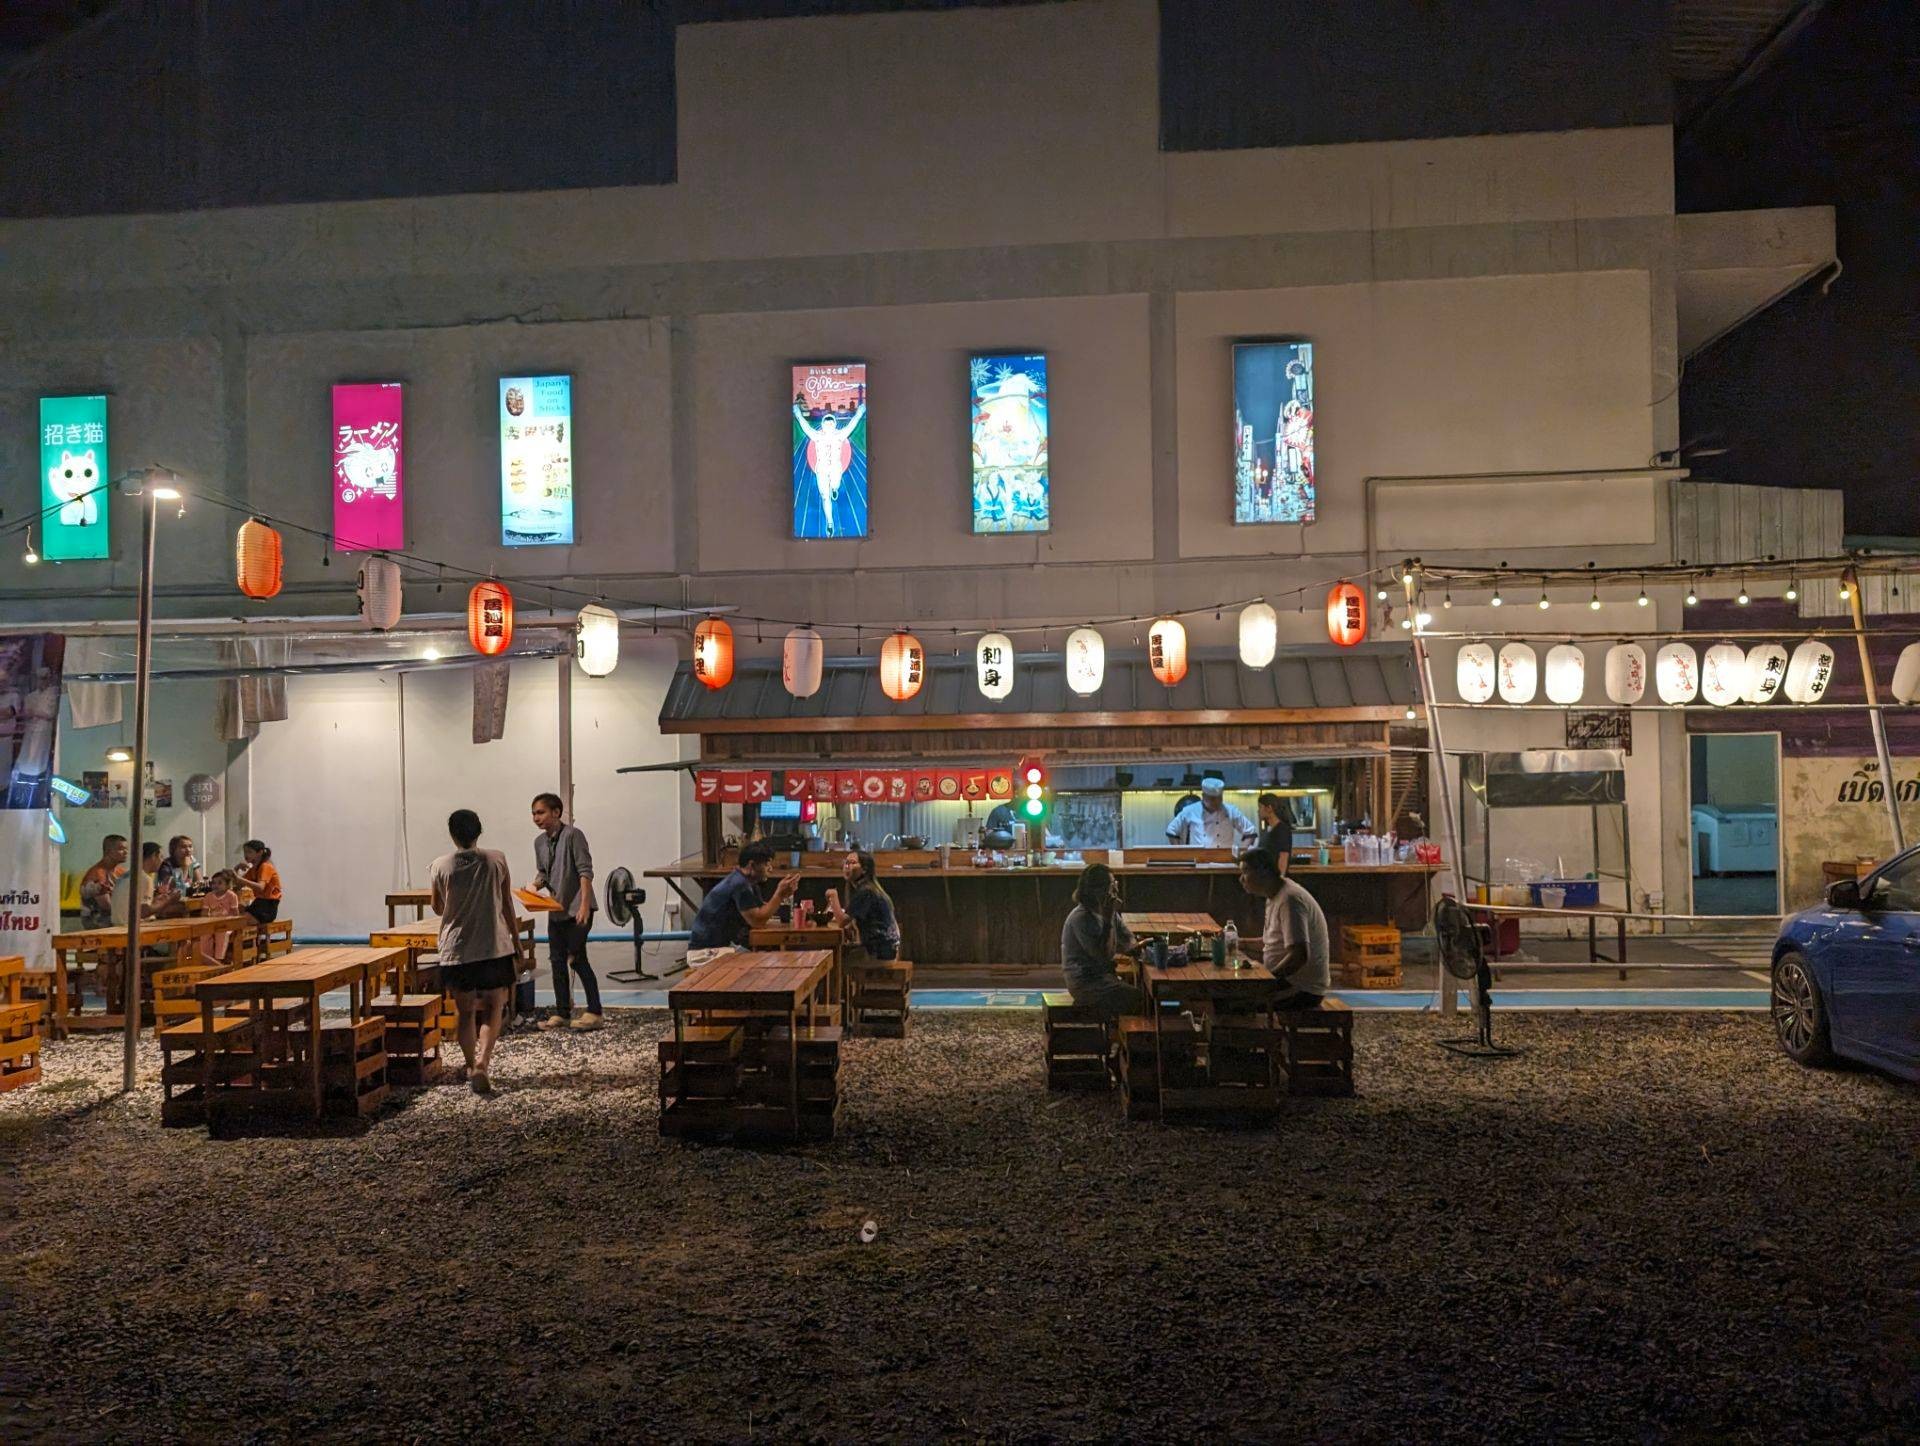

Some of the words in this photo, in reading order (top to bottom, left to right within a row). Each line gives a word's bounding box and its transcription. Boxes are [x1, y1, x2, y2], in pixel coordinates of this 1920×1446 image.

[44, 422, 104, 446] 招き猫
[338, 421, 399, 443] ラーメン
[982, 646, 1002, 687] 刺身
[700, 777, 807, 798] ラーメン
[191, 795, 213, 803] STOP
[0, 911, 40, 931] ไทย
